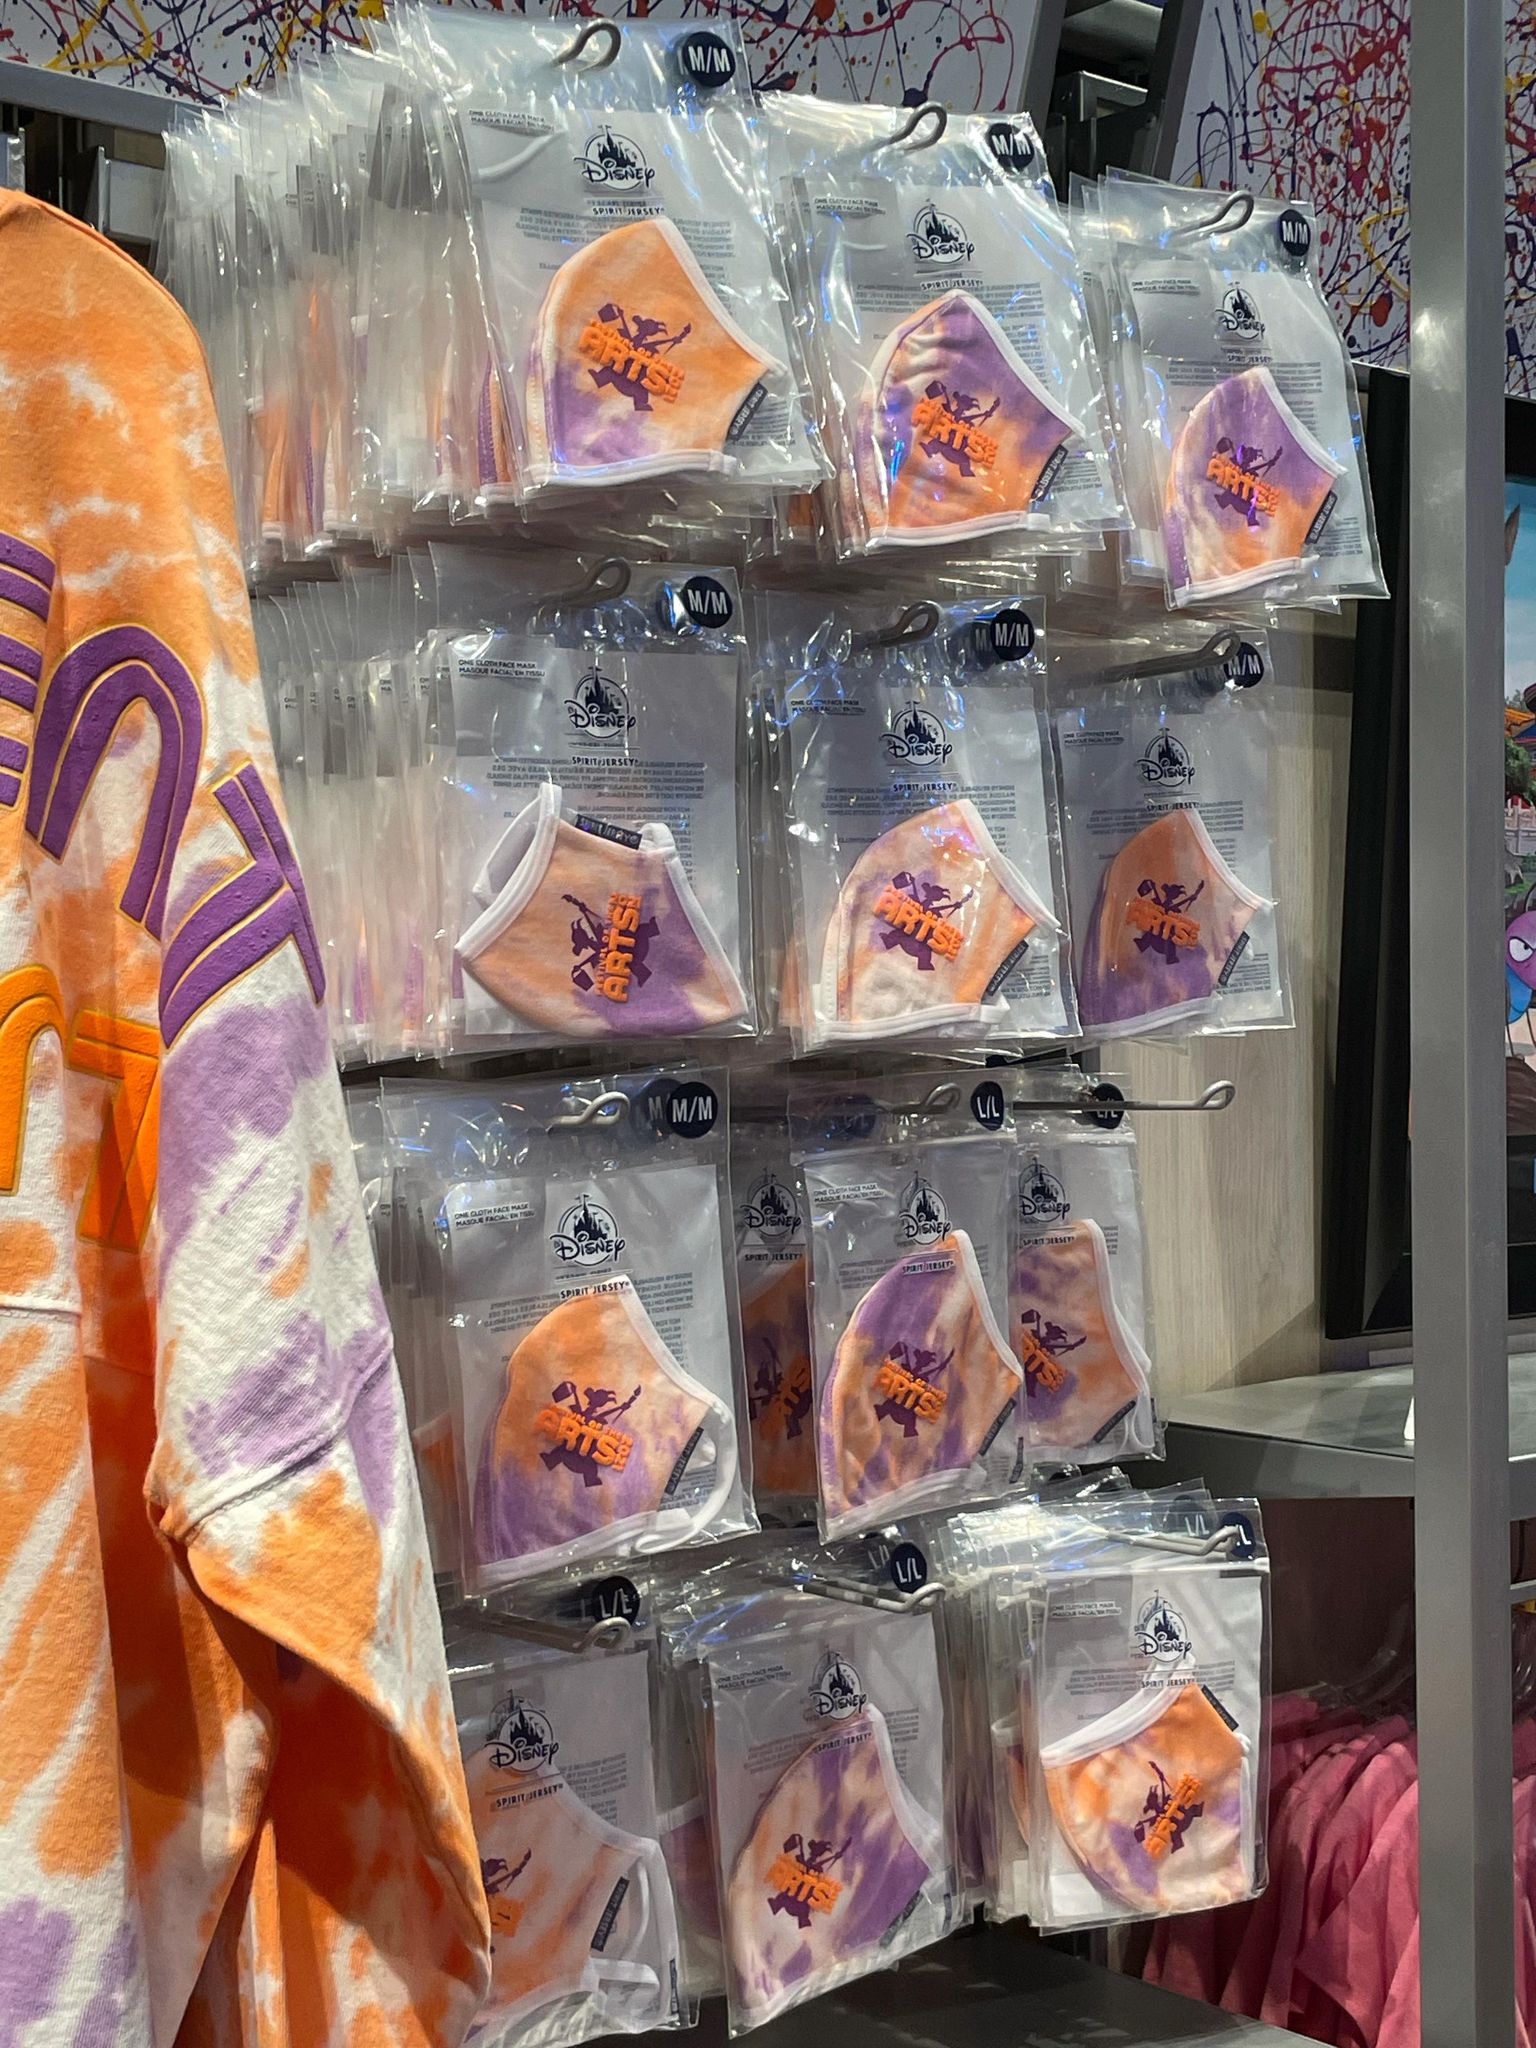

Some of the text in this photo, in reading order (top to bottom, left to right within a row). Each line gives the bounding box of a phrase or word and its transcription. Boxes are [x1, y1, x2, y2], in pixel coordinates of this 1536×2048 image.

[687, 46, 730, 74] M/M
[992, 134, 1031, 156] M/M
[1281, 221, 1308, 244] M/M
[578, 326, 671, 396] ARTS
[911, 403, 986, 463] ARTS
[688, 588, 728, 615] M/M
[995, 623, 1029, 647] M/M
[873, 891, 957, 956] ARTS
[604, 899, 642, 1002] ARTS
[672, 1096, 713, 1123] M/M
[977, 1096, 1000, 1119] L/L
[455, 1211, 469, 1219] ONE
[471, 1208, 492, 1217] CLOTH
[456, 1218, 484, 1226] MASQUE
[486, 1214, 507, 1223] FACIAL
[561, 1288, 590, 1299] SPIRIT
[534, 1407, 618, 1467] ARTS
[895, 1558, 922, 1584] L/L
[496, 1792, 525, 1808] SPIRIT
